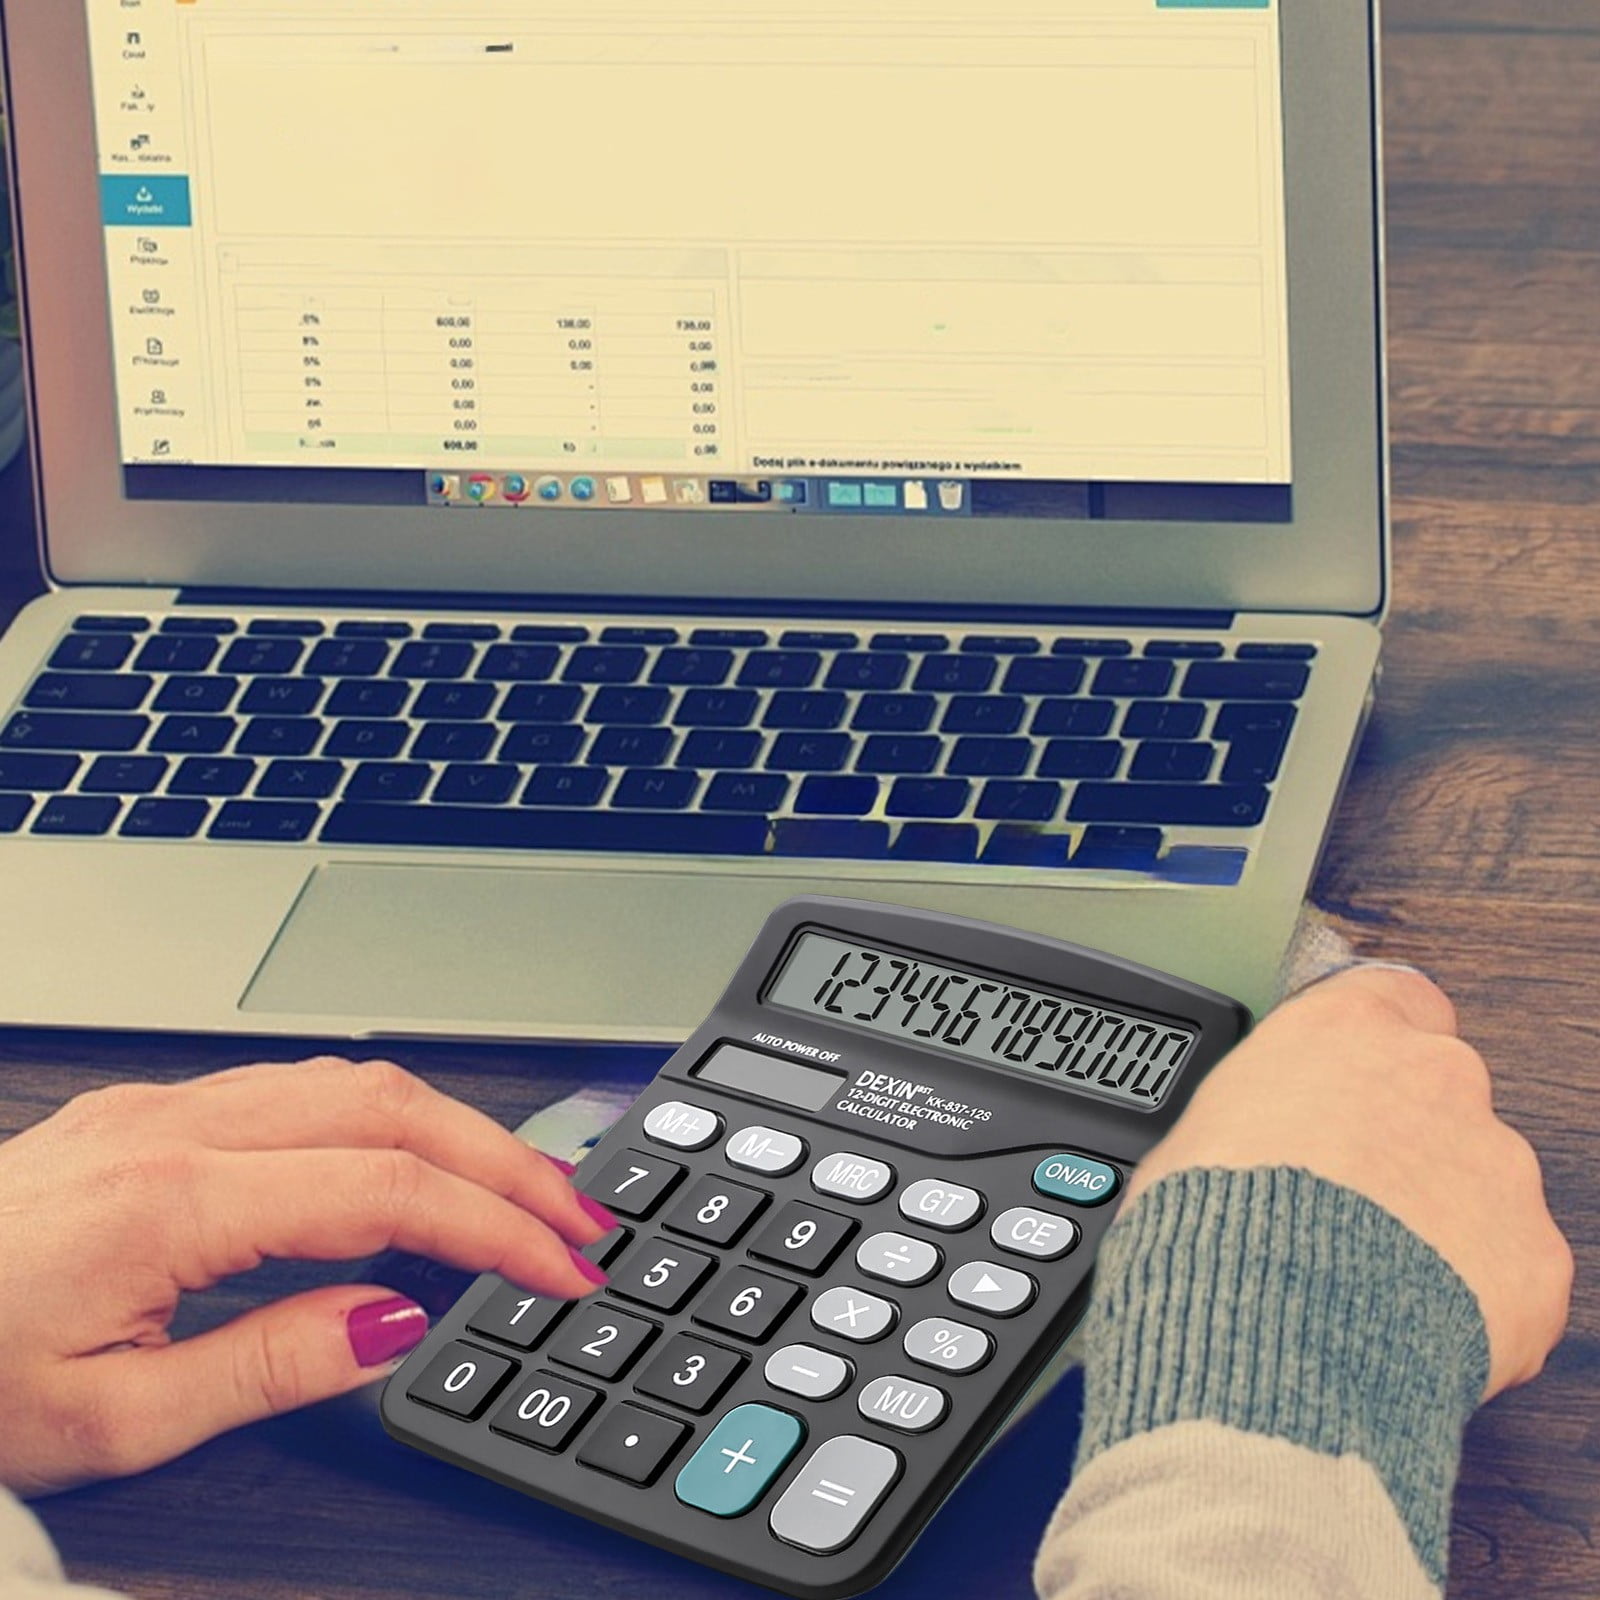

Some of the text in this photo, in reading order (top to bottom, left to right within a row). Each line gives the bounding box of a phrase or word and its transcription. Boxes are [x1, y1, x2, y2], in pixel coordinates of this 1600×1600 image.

[753, 456, 784, 470] Dodaj
[751, 1032, 842, 1063] AUTO POWER OFF
[846, 1088, 974, 1131] 12-DIGIT ELECTRONIC
[855, 1070, 920, 1100] DEXIN
[925, 1095, 993, 1122] KK-837-12S
[655, 1107, 700, 1136] M+
[836, 1100, 918, 1131] CALCULATOR
[613, 1165, 650, 1194] 7
[826, 1160, 880, 1192] MRC
[1044, 1161, 1107, 1192] ON/AC
[696, 1195, 730, 1225] 8
[918, 1188, 965, 1217] GT
[784, 1220, 817, 1250] 9
[1010, 1216, 1058, 1248] CE
[642, 1257, 679, 1288] 5
[509, 1296, 537, 1325] 1
[729, 1286, 763, 1317] 6
[580, 1325, 618, 1357] 2
[443, 1361, 477, 1393] 0
[672, 1355, 706, 1386] 3
[517, 1388, 572, 1428] 00
[872, 1384, 929, 1421] MU
